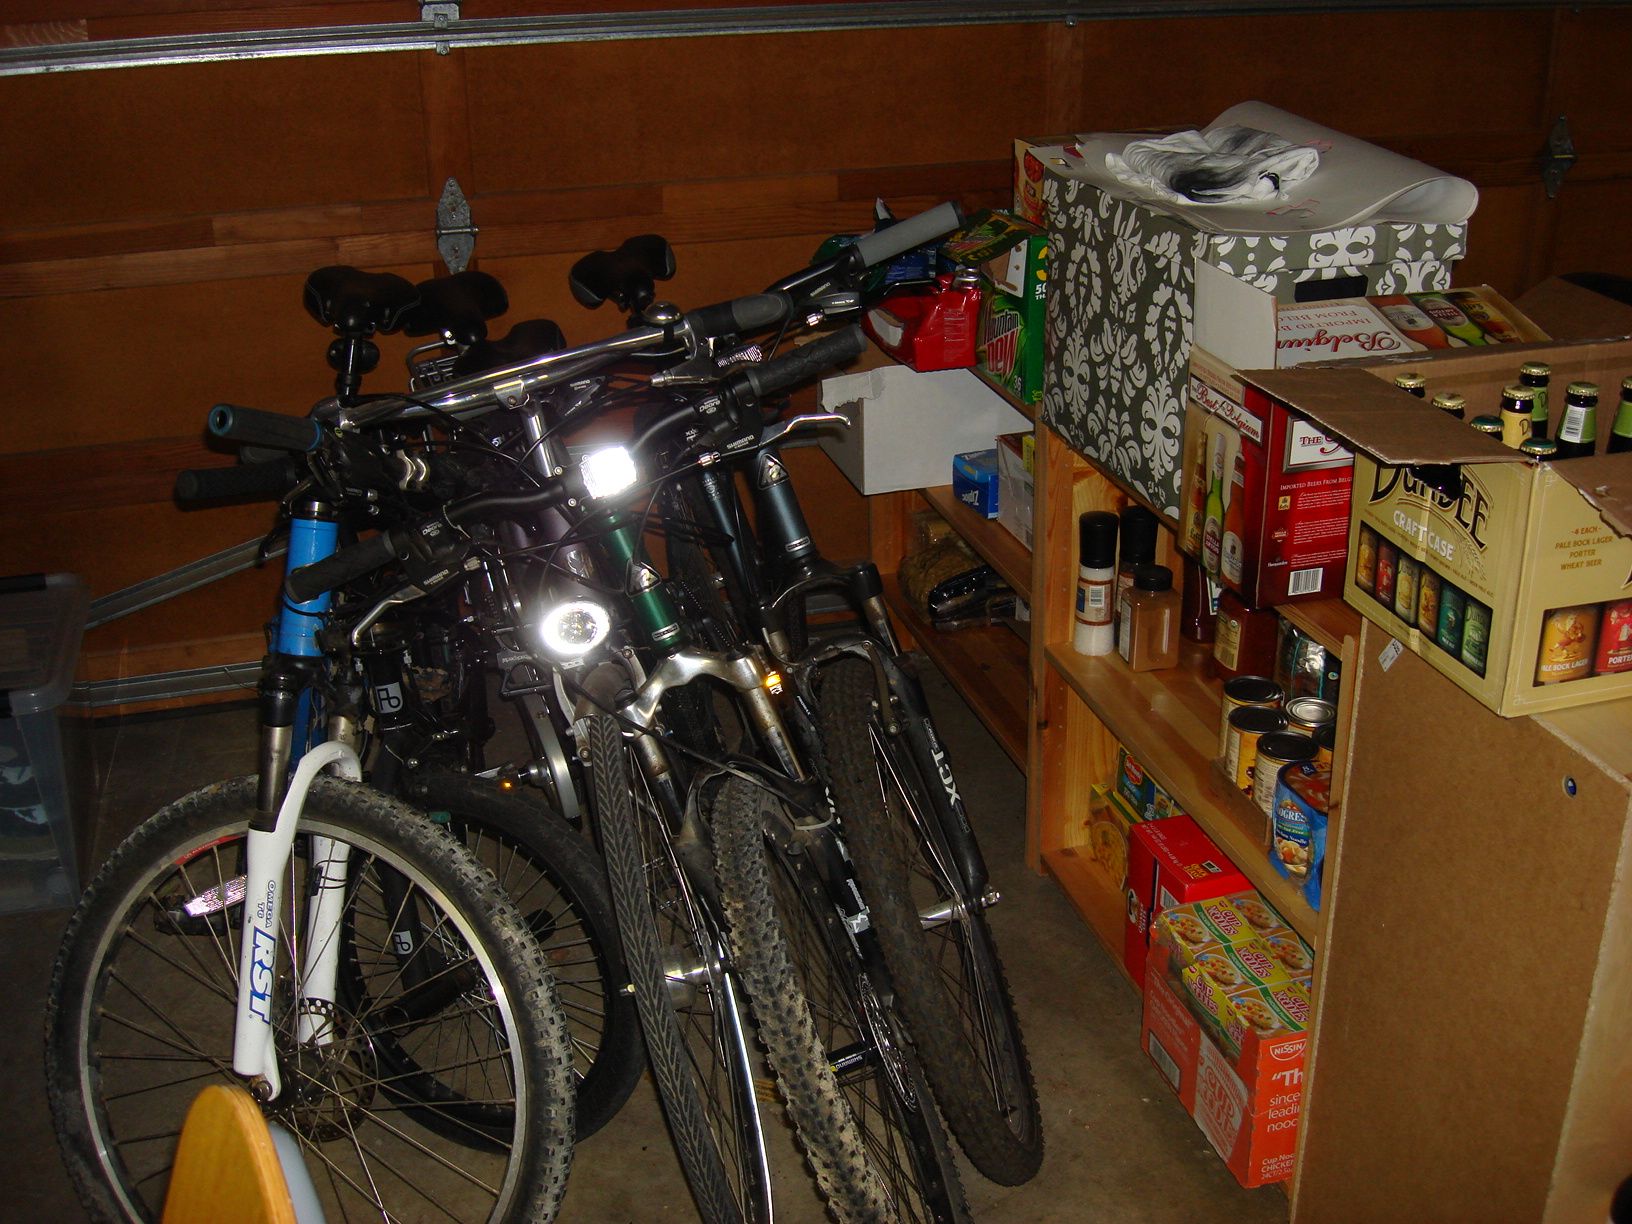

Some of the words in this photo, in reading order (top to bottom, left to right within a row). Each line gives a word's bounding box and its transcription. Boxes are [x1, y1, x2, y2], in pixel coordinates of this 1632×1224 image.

[1315, 310, 1360, 321] FROM
[1295, 318, 1372, 330] IMPORTED
[700, 400, 721, 413] Deore
[726, 434, 755, 450] SHIMANO
[1299, 436, 1323, 448] THE
[1280, 482, 1306, 491] IMPORTED
[1323, 478, 1338, 486] FROM
[1393, 511, 1428, 542] CRAFT
[1427, 533, 1455, 561] CASE
[1555, 541, 1572, 549] PALE
[1572, 538, 1591, 547] BOCK
[1592, 535, 1614, 545] LAGER
[1569, 549, 1596, 559] PORTER
[1560, 561, 1584, 570] WHEAT
[1585, 559, 1602, 568] BEER
[1552, 663, 1571, 671] BOCK
[931, 749, 961, 807] XCT
[265, 880, 276, 929] OMEGA
[1205, 904, 1239, 936] NOODLES
[1221, 910, 1242, 927] CUP
[1236, 946, 1272, 979] NOODLES
[1252, 952, 1275, 972] CUP
[249, 926, 277, 1026] RST
[1196, 975, 1214, 997] CUP
[1273, 1042, 1303, 1056] NISSIN
[1269, 1091, 1301, 1106] since
[1262, 1157, 1278, 1166] Cup
